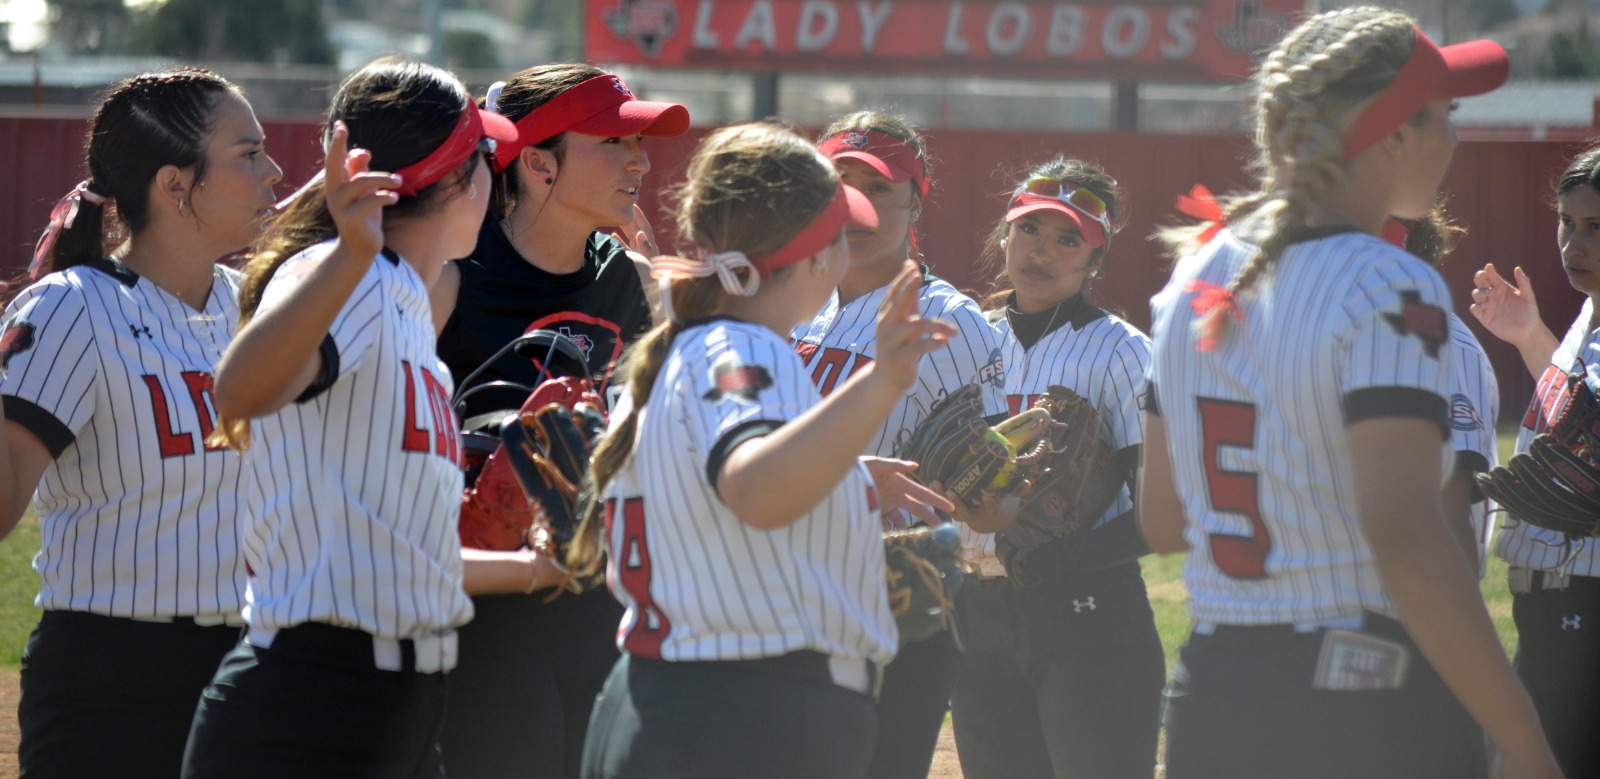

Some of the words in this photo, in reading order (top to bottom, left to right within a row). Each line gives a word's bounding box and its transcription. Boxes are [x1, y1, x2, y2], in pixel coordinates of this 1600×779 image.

[693, 0, 895, 52] LADY
[943, 0, 1201, 60] LOBOS
[953, 464, 981, 494] A2000
[1196, 396, 1272, 580] 5
[605, 496, 671, 661] 8
